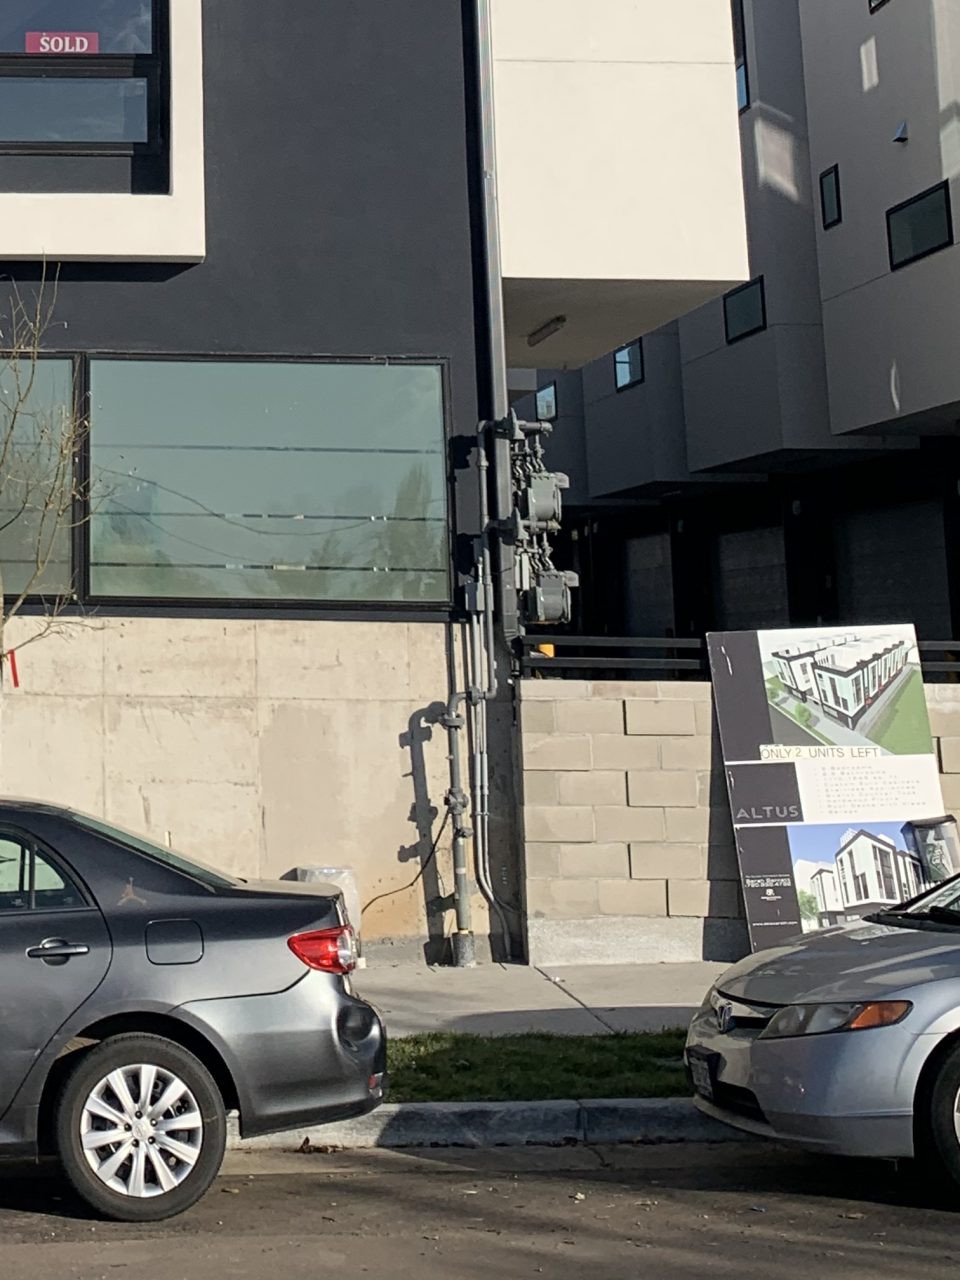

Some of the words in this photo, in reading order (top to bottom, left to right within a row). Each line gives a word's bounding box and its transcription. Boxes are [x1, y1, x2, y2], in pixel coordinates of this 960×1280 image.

[39, 36, 89, 53] SOLD
[761, 747, 792, 759] ONLY
[795, 747, 802, 757] 2
[808, 747, 845, 759] UNITS
[850, 747, 879, 758] LEFT
[736, 805, 800, 819] ALTUS
